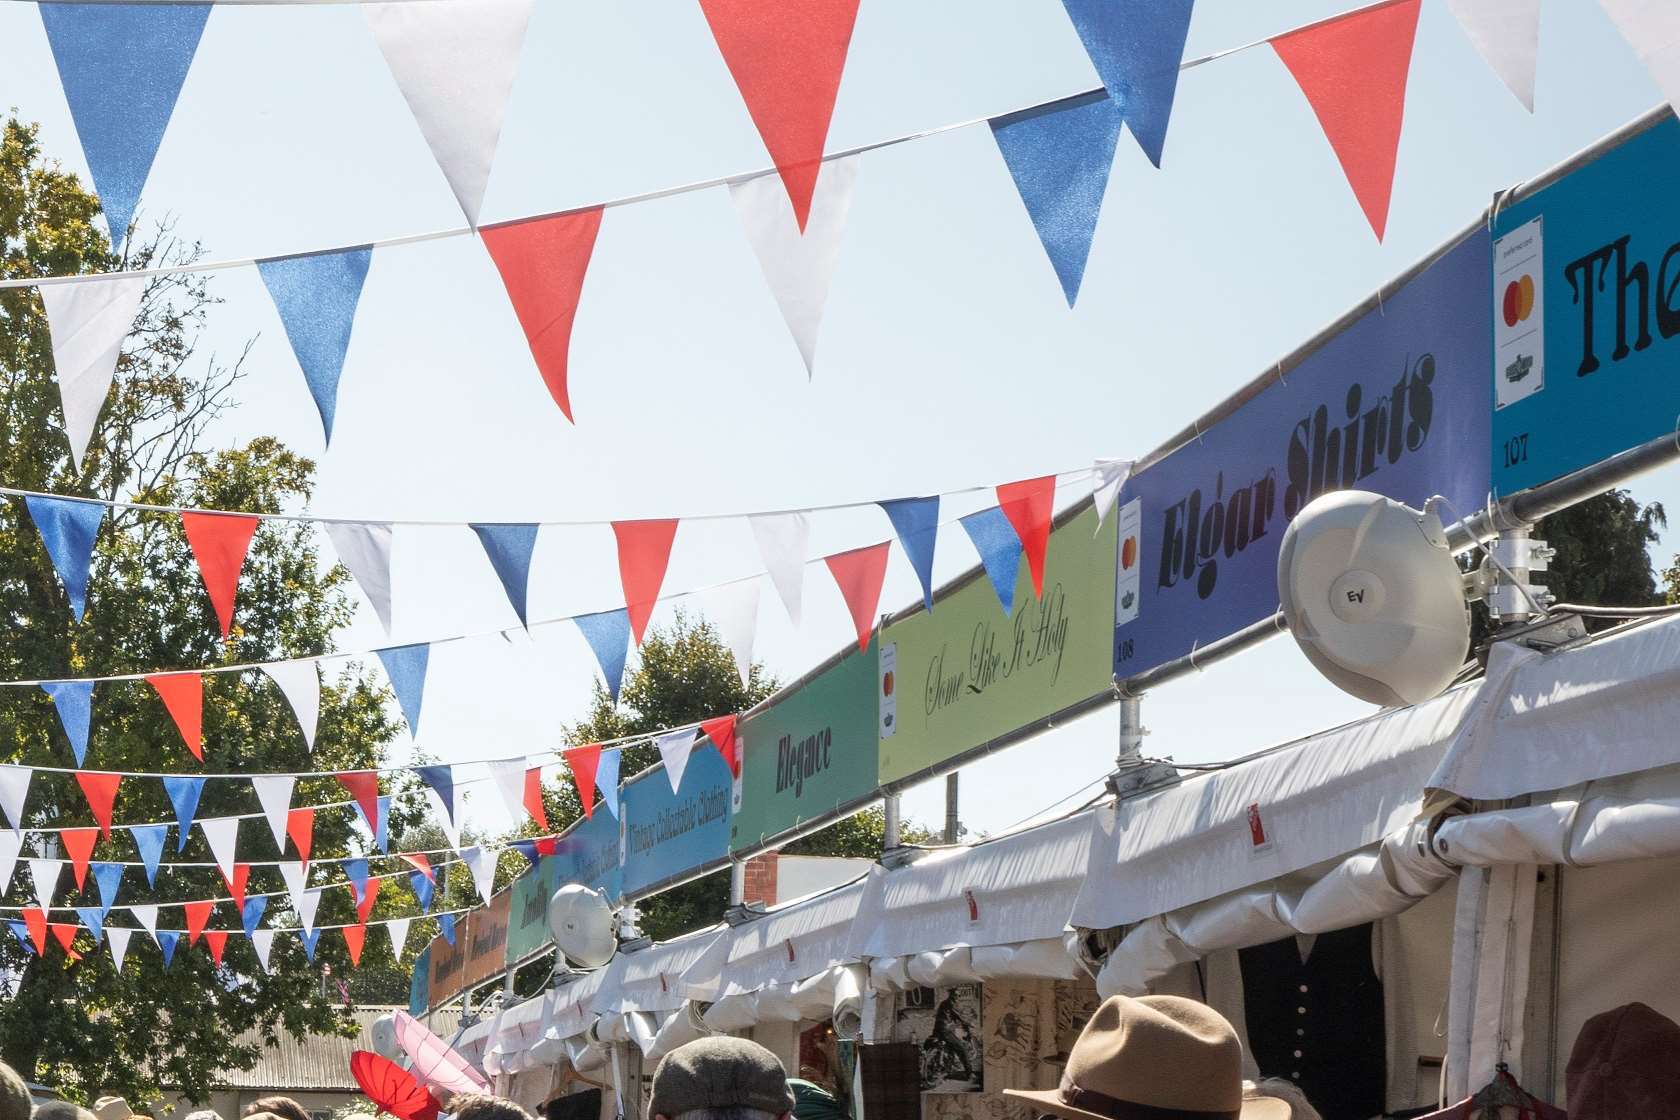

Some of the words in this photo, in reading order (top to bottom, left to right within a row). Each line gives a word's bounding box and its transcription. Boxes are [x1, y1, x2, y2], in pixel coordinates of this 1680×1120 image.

[1157, 468, 1276, 600] Elgar
[1284, 351, 1436, 523] Shirts
[1503, 432, 1529, 469] 107
[1346, 589, 1365, 603] EV
[924, 643, 964, 724] Some
[966, 621, 1001, 695] Like
[775, 726, 832, 799] Elegance
